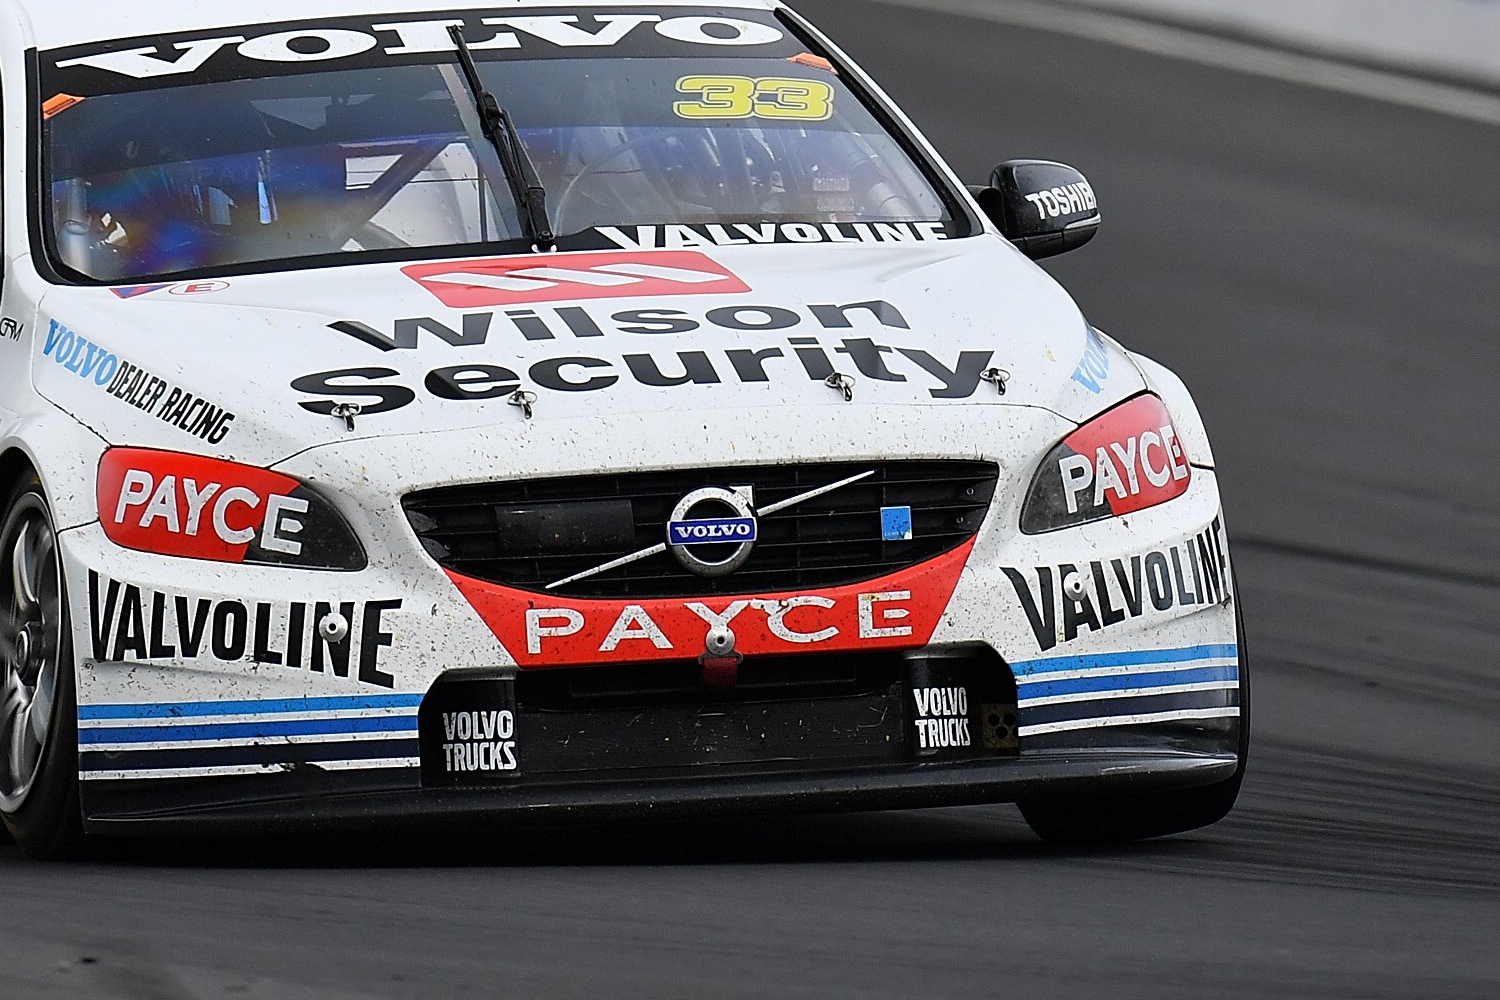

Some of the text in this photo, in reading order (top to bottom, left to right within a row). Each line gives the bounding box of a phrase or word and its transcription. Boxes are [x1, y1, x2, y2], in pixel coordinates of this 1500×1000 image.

[56, 14, 784, 79] VOLVO
[673, 75, 834, 121] 33
[1024, 182, 1097, 220] TOSHIB
[595, 222, 950, 250] VALVOLINE
[327, 300, 911, 352] Wilson
[42, 318, 236, 445] VOLVO DEALER RACING
[291, 337, 996, 416] Security
[1058, 425, 1189, 514] PAYCE
[114, 469, 310, 556] PAYCE
[675, 523, 750, 539] VOLVO
[88, 568, 403, 690] VALVOLINE
[526, 590, 913, 655] PAYCE
[443, 710, 514, 741] VOLVO
[914, 686, 968, 716] VOLVO
[443, 740, 517, 772] TRUCKS
[915, 718, 971, 748] TRUCKS
